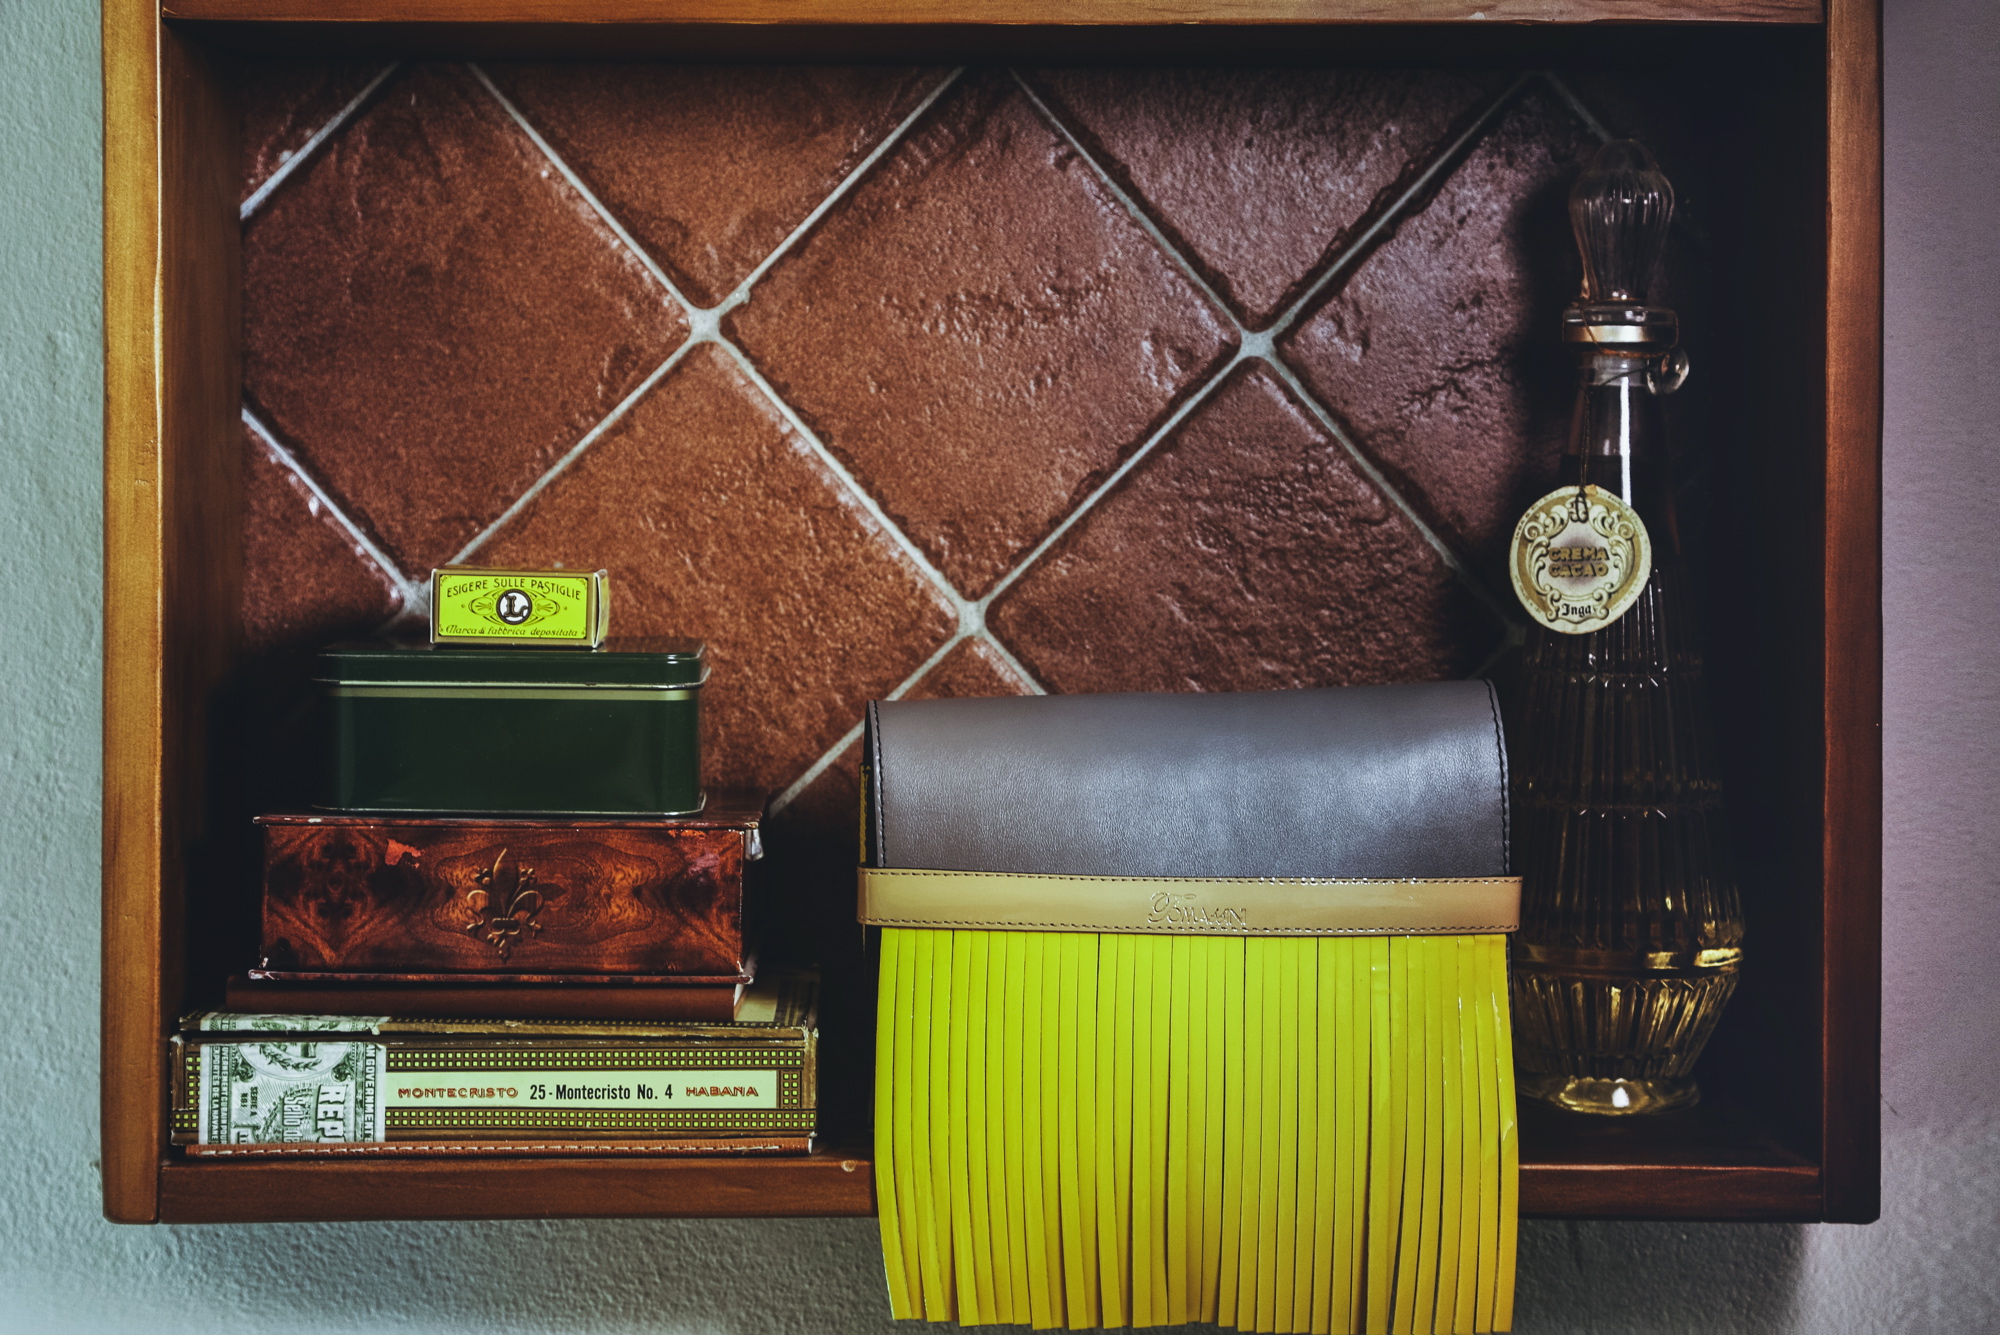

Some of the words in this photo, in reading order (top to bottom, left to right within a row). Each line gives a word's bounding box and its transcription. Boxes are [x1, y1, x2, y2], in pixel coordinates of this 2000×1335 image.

[1549, 546, 1610, 562] CREMA
[1548, 563, 1609, 578] CACAO
[446, 579, 488, 598] ESIGERE
[494, 578, 525, 588] SULLE
[531, 580, 581, 600] PASTIGLIE
[504, 595, 529, 618] L
[1561, 603, 1592, 618] Inga
[446, 625, 476, 635] Marca
[487, 626, 526, 636] fabbrica
[530, 627, 578, 639] depositata
[397, 1087, 519, 1099] MONTECRISTO
[636, 1083, 658, 1100] No.
[664, 1083, 673, 1100] 4
[685, 1086, 759, 1097] HABANA
